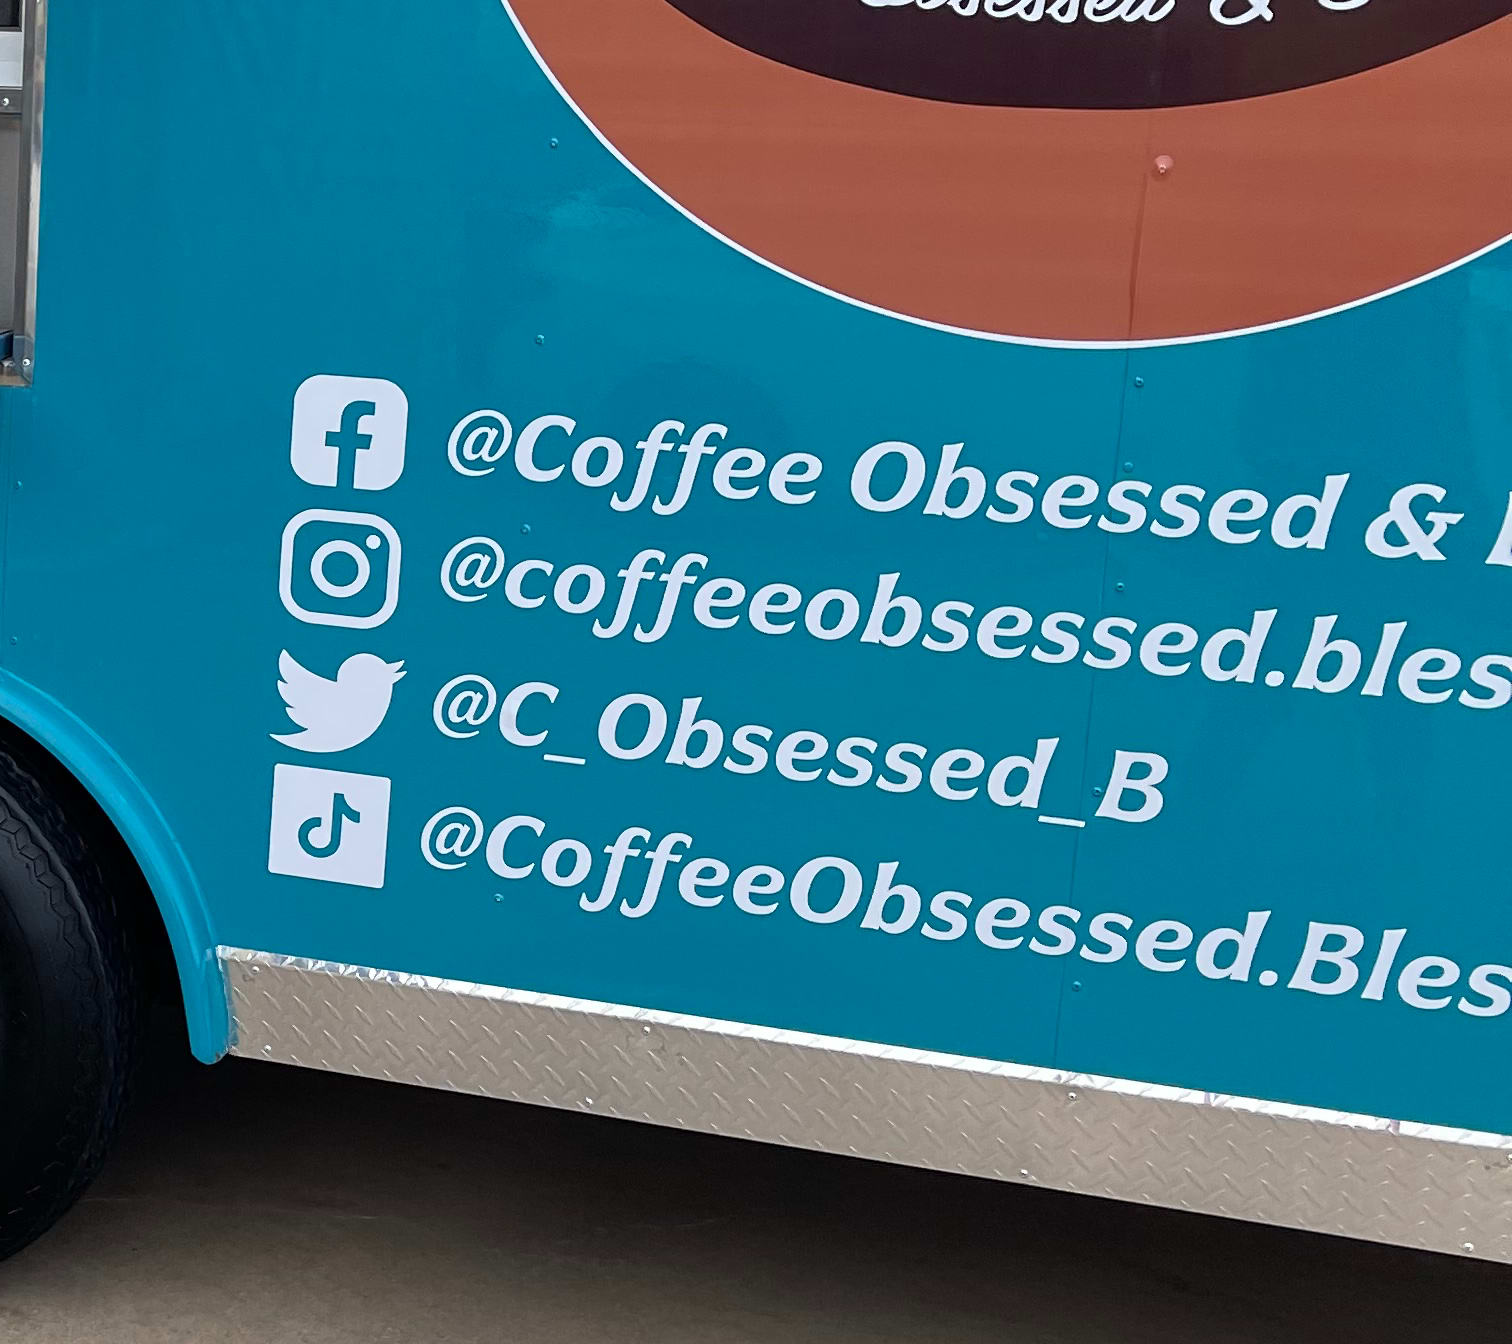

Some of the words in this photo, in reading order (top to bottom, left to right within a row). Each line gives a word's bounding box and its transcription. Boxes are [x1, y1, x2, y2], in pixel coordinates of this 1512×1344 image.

[447, 409, 823, 516] @Coffee
[850, 441, 1350, 550] Obsessed
[1364, 483, 1465, 561] &
[440, 536, 1512, 709] @coffeeobsessed.bles
[432, 674, 1169, 828] @C_Obsessed_B
[420, 806, 1512, 1017] @CoffeeObsessed.Bles
